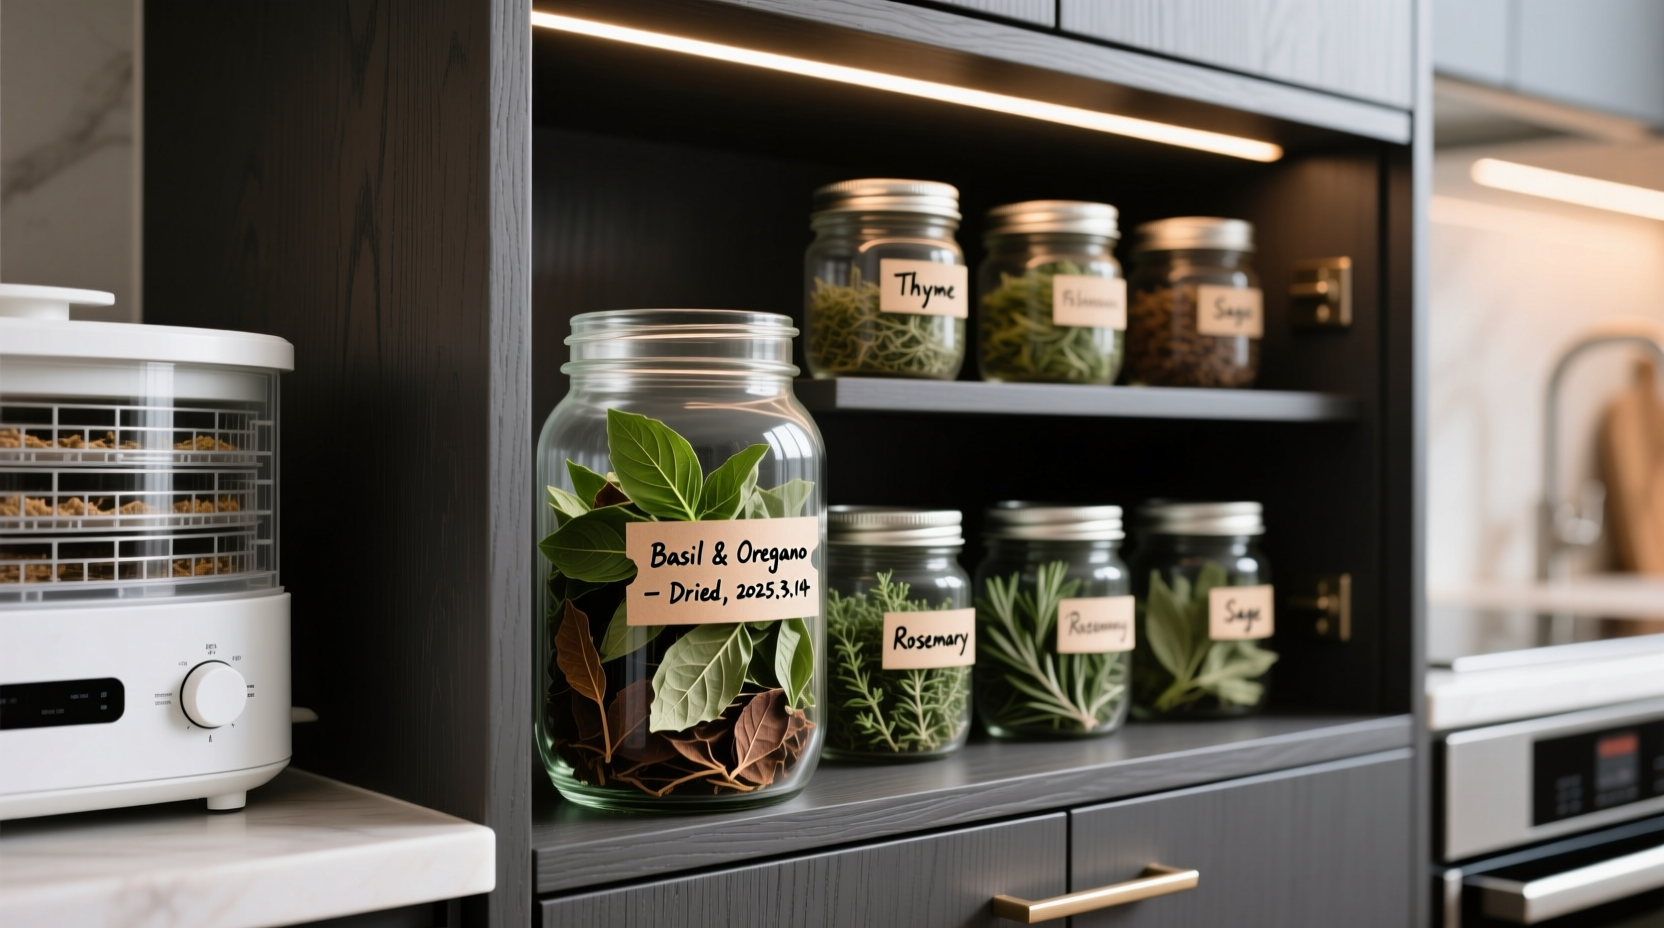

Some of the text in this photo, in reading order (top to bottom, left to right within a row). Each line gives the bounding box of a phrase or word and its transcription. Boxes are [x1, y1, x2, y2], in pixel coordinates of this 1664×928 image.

[893, 271, 955, 309] Thyme
[650, 539, 808, 574] Basil & Oregano
[669, 578, 729, 606] Dried,
[736, 578, 811, 600] 2025.3.14
[893, 625, 969, 657] Rosemary
